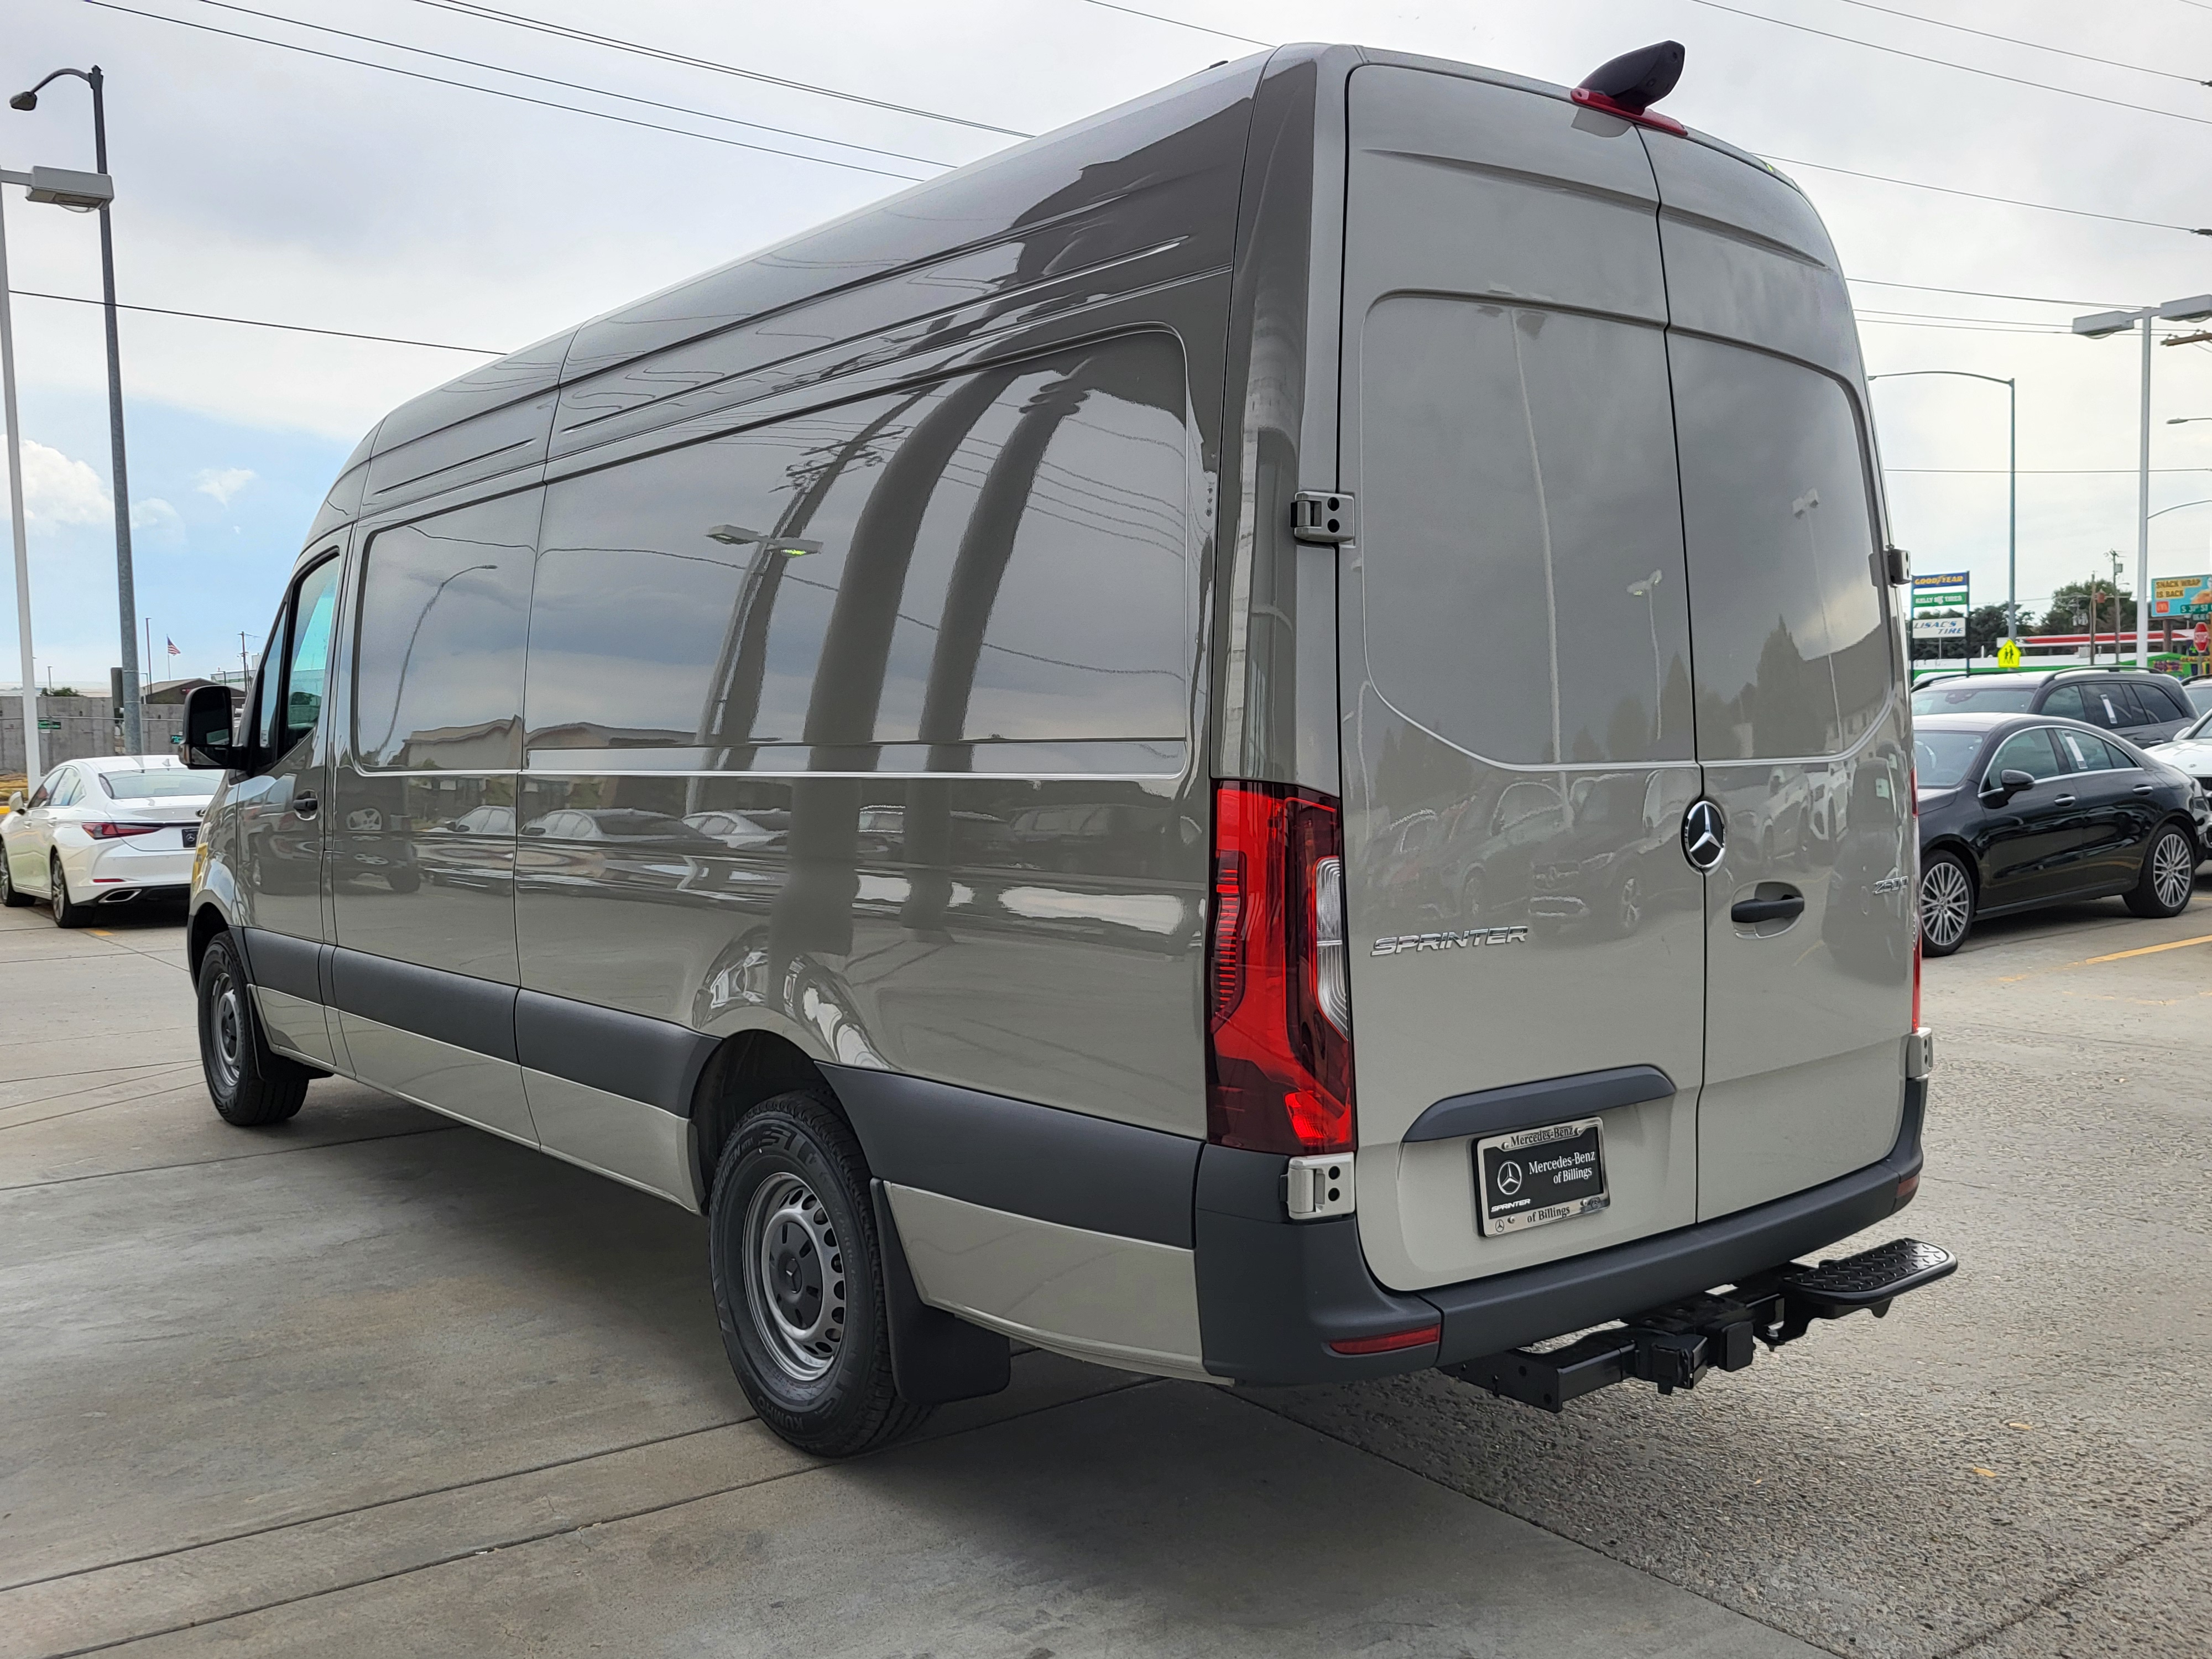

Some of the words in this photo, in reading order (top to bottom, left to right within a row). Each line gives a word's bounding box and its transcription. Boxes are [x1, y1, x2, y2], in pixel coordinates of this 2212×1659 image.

[1914, 576, 1963, 585] GOODYEAR
[1370, 925, 1528, 957] SPRINTER
[1510, 1126, 1573, 1147] Mercedes-Benz
[1528, 1150, 1595, 1175] Mercedes-Benz
[1553, 1172, 1562, 1184] of
[1563, 1167, 1592, 1182] Billings
[1491, 1198, 1531, 1212] SPRINTER
[1527, 1212, 1537, 1223] of
[1538, 1206, 1570, 1221] Billings
[757, 1395, 805, 1431] KUMHO
